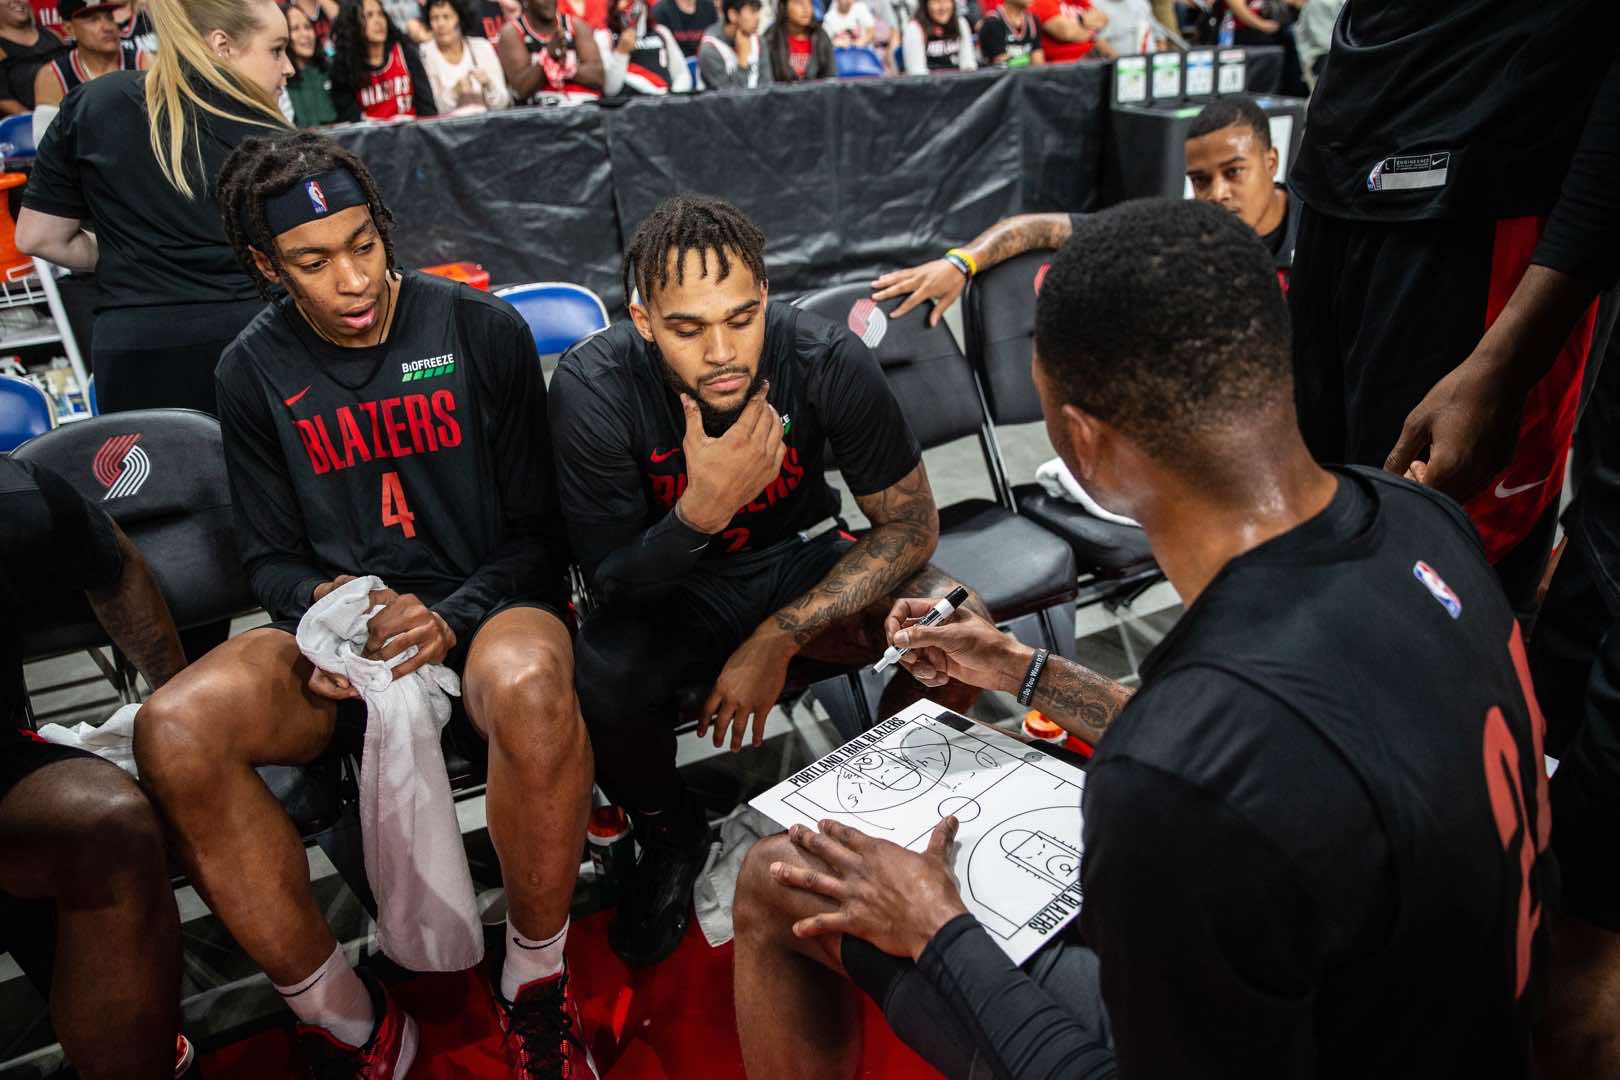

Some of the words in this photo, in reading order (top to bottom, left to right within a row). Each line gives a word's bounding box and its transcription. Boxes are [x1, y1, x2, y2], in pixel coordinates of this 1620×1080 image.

[290, 388, 463, 476] BLAZERS
[381, 471, 417, 539] 4
[1025, 677, 1035, 688] You
[1030, 662, 1042, 677] Want
[788, 752, 844, 788] PORTLAND
[838, 739, 871, 760] TRAIL
[861, 716, 906, 744] BLAZERS
[1027, 893, 1081, 936] BLAZERS
